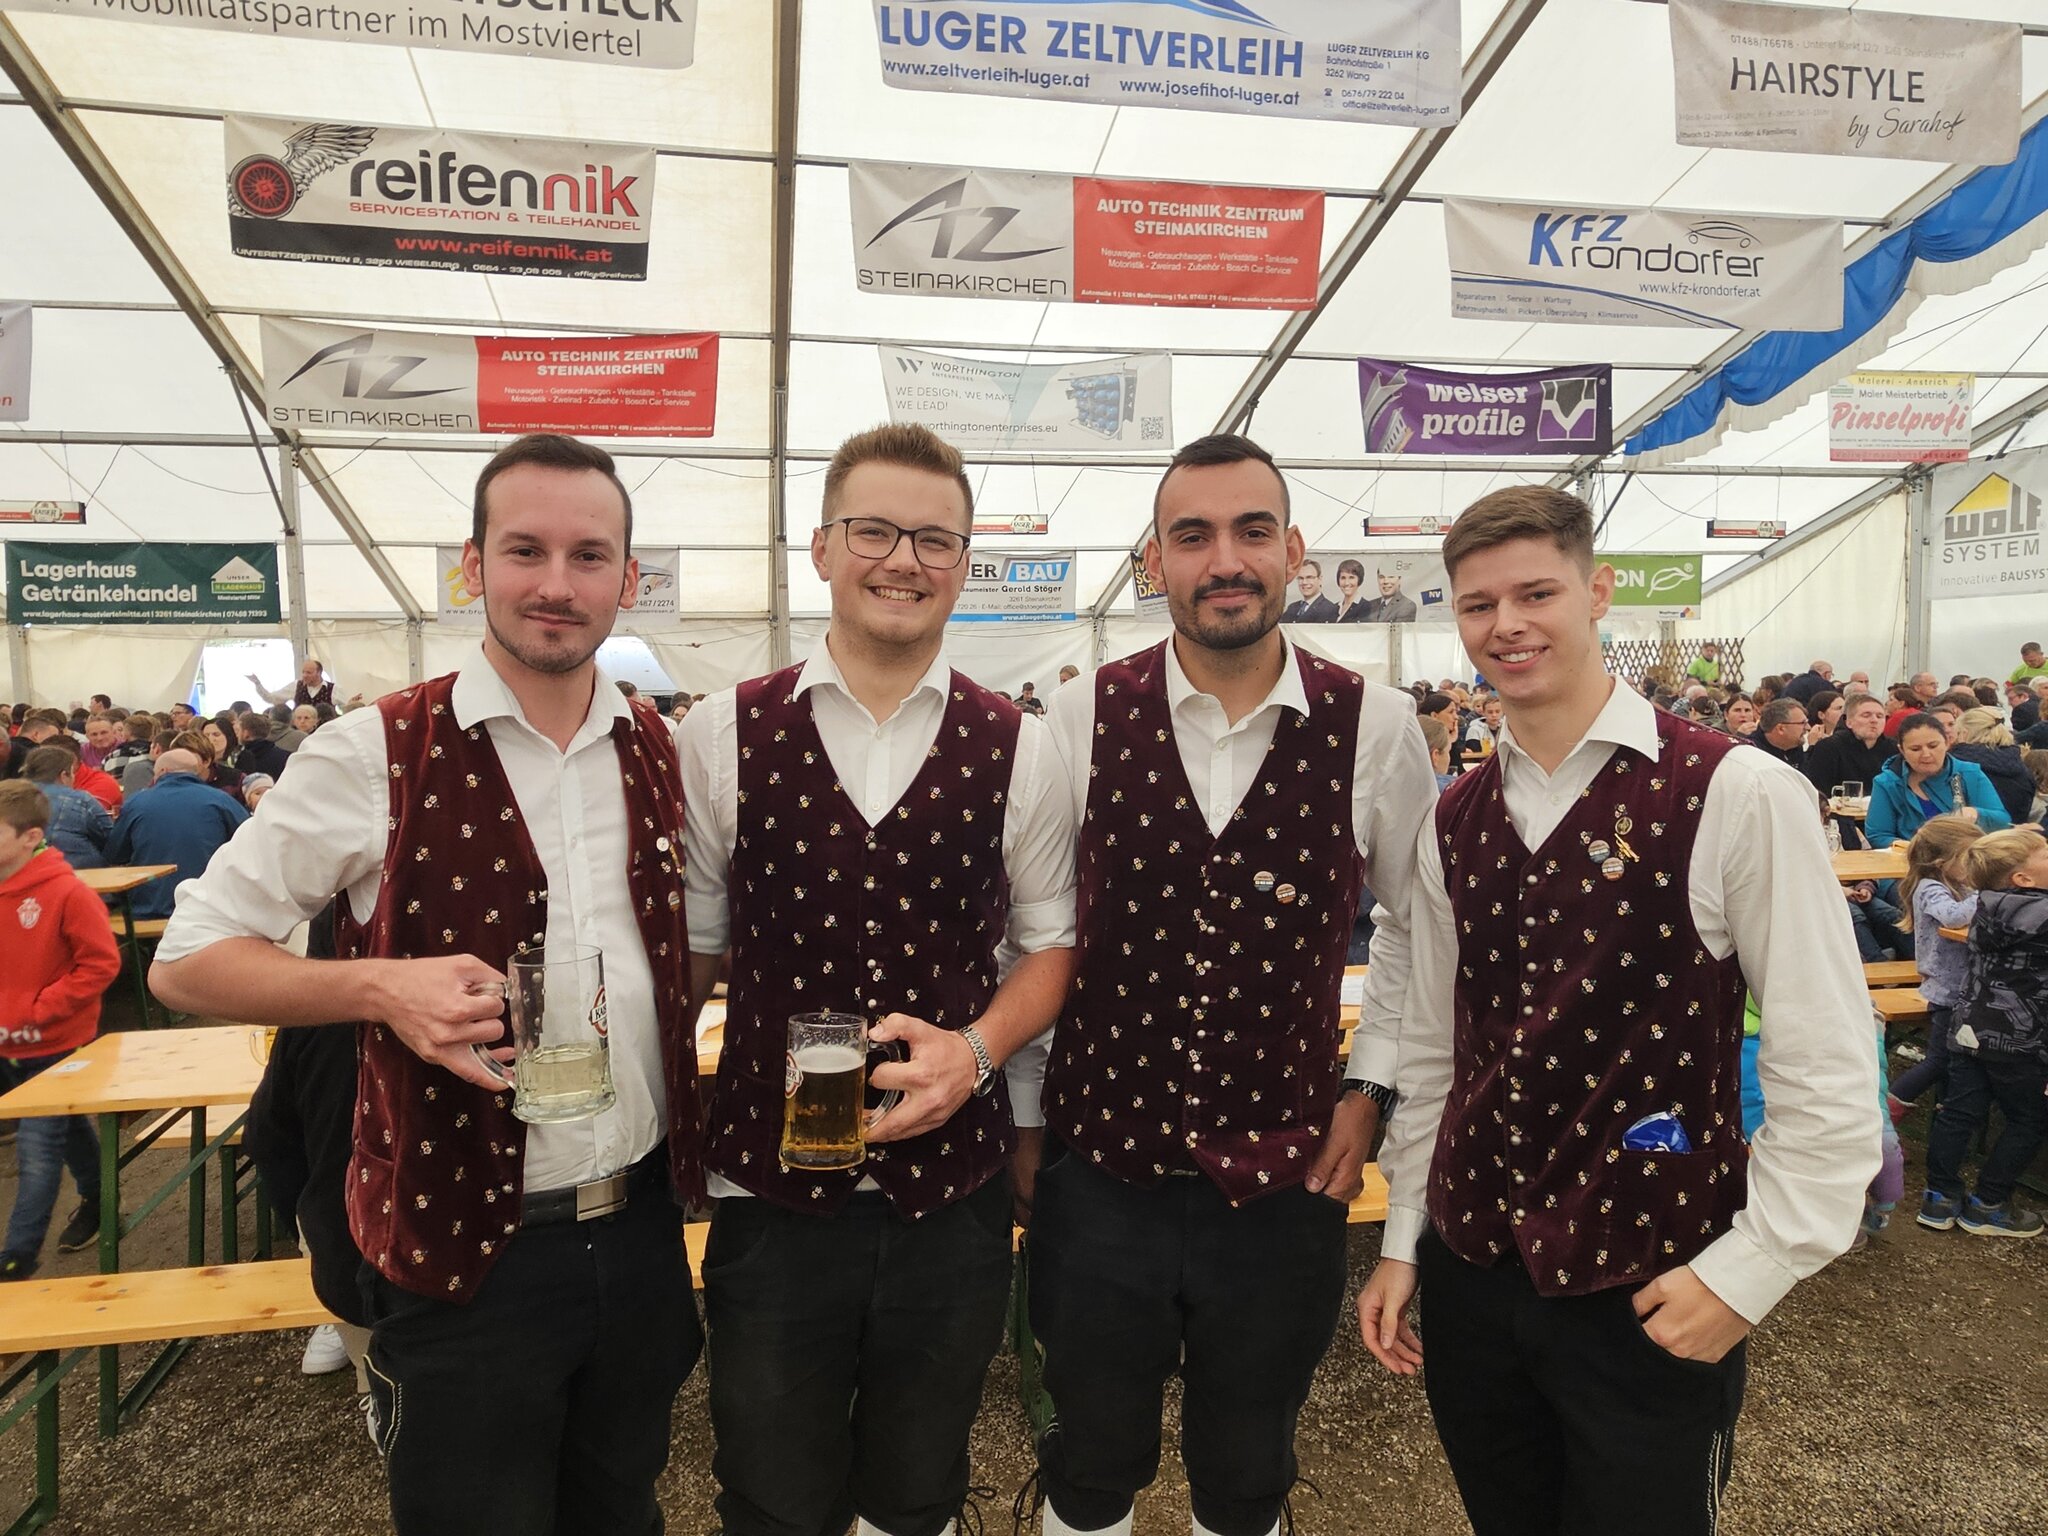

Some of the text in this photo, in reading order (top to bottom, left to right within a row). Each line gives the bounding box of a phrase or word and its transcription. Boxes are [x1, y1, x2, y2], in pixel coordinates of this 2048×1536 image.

[409, 7, 447, 38] im
[462, 12, 641, 57] Mostviertel
[880, 5, 1303, 78] LUGER ZELTVERLEIH
[1327, 43, 1430, 60] LUGER ZELTVERLEIH KG
[883, 58, 1300, 106] www.zeltverleih-luger.at www.josefihof-luger.at
[1325, 68, 1370, 81] 3262 Wang
[1730, 57, 1925, 103] HAIRSTYLE
[1378, 90, 1392, 100] 222
[1847, 115, 1869, 148] by
[350, 149, 640, 217] reifennik
[350, 202, 641, 231] SERVICESTATION & TEILEHANDEL
[1097, 199, 1304, 221] AUTO TECHNIK ZENTRUM
[1134, 220, 1268, 238] STEINAKIRCHEN
[394, 237, 613, 263] www.reifennik.at
[1101, 247, 1141, 259] Neuwagen
[1148, 251, 1212, 262] Gebrauchtwagen
[1151, 262, 1181, 271] Zweirad
[1188, 262, 1220, 272] Zubehör
[1226, 263, 1249, 273] Bosch
[1251, 265, 1264, 273] Car
[1265, 265, 1291, 275] Service
[859, 269, 1066, 295] STEINAKIRCHEN
[1639, 282, 1760, 298] www.kfz-krondorfer.at
[1507, 294, 1532, 303] Service
[501, 347, 698, 362] AUTO TECHNIK ZENTRUM
[537, 363, 665, 376] STEINAKIRCHEN
[931, 361, 1021, 378] WORTHINGTON
[1906, 378, 1948, 386] Anstrich
[504, 387, 543, 396] Neuwagen
[550, 387, 611, 397] Gebrauchtwagen
[896, 386, 913, 397] WE
[965, 391, 982, 400] WE
[1425, 383, 1528, 404] welser
[1859, 390, 1883, 398] Maler
[1885, 390, 1948, 399] Meisterbetrieb
[649, 398, 662, 406] Car
[664, 399, 690, 407] Service
[896, 401, 948, 411] WE LEAD!
[273, 407, 473, 428] STEINAKIRCHEN
[1421, 408, 1526, 439] profile
[1831, 401, 1970, 437] Pinselprofi
[1943, 539, 2040, 563] SYSTEM
[21, 560, 137, 581] Lagerhaus
[1016, 564, 1062, 581] BAU
[2000, 568, 2048, 582] BAUSYS
[22, 584, 197, 602] Getränkehandel
[1001, 585, 1031, 593] Gerold
[1034, 585, 1062, 594] Stöger
